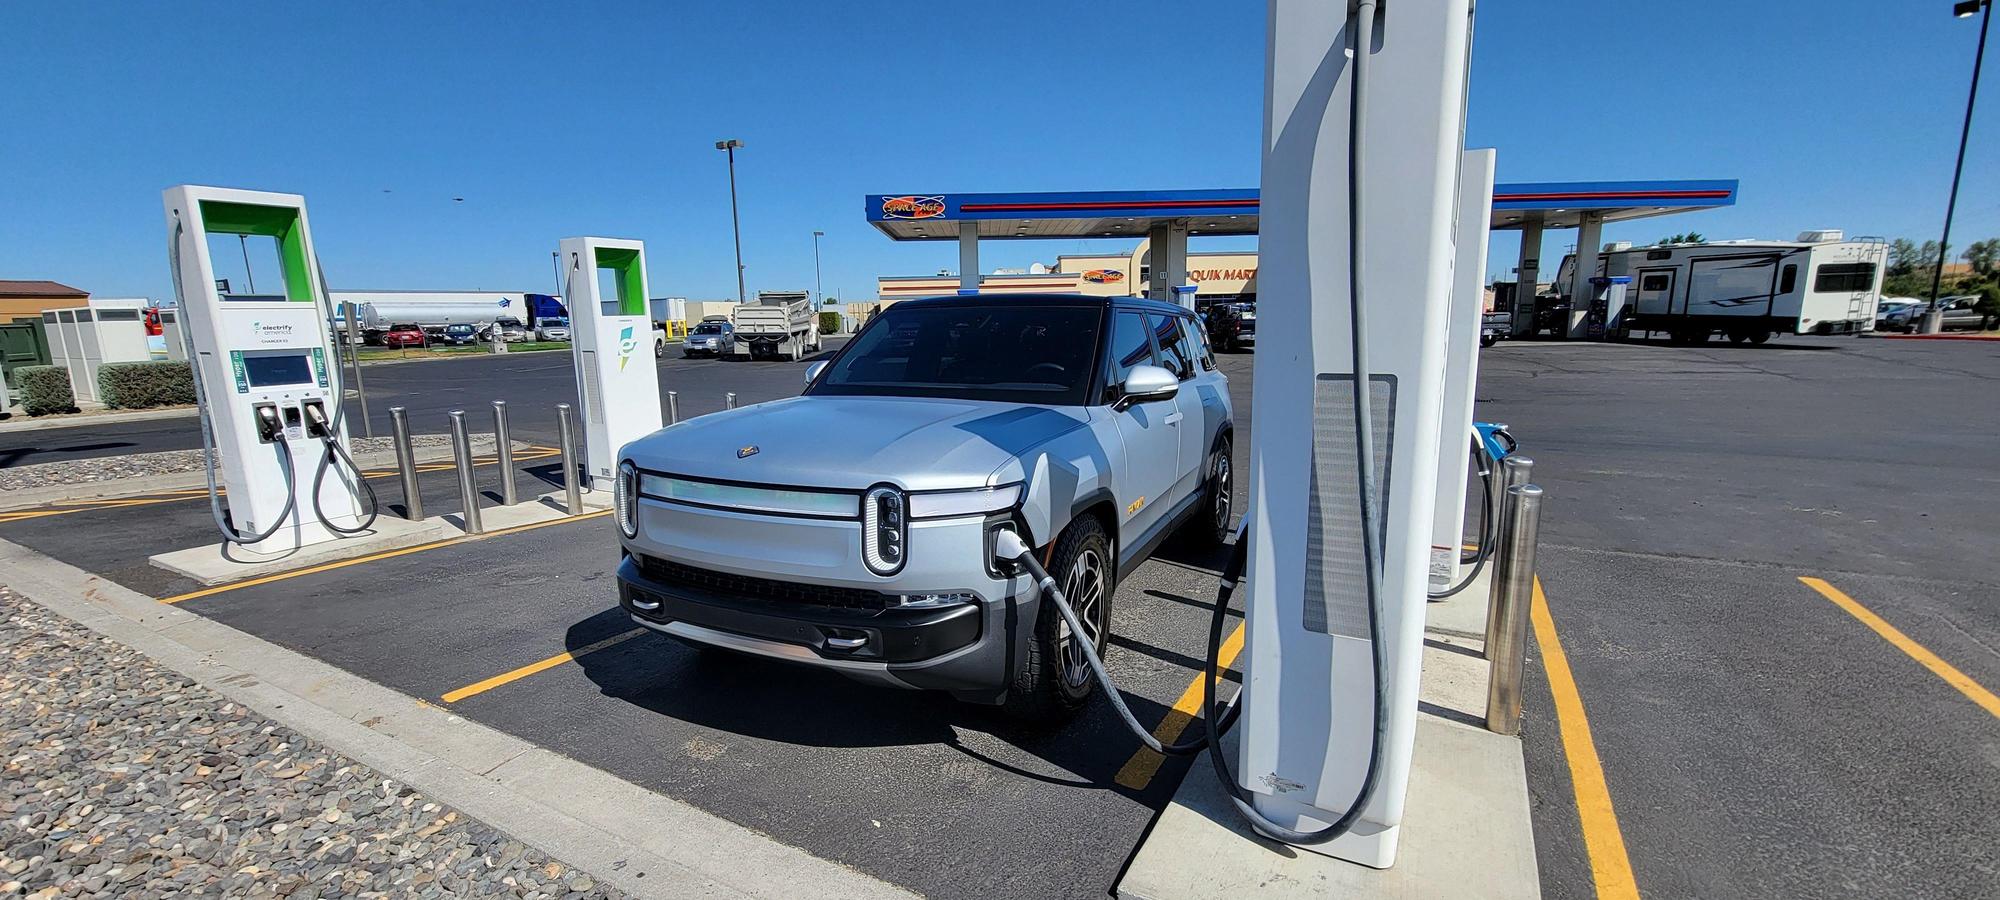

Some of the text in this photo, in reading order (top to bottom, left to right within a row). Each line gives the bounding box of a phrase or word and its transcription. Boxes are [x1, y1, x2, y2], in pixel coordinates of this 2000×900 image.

[887, 202, 940, 212] SPACE AGE
[1190, 269, 1258, 283] QUIK MART
